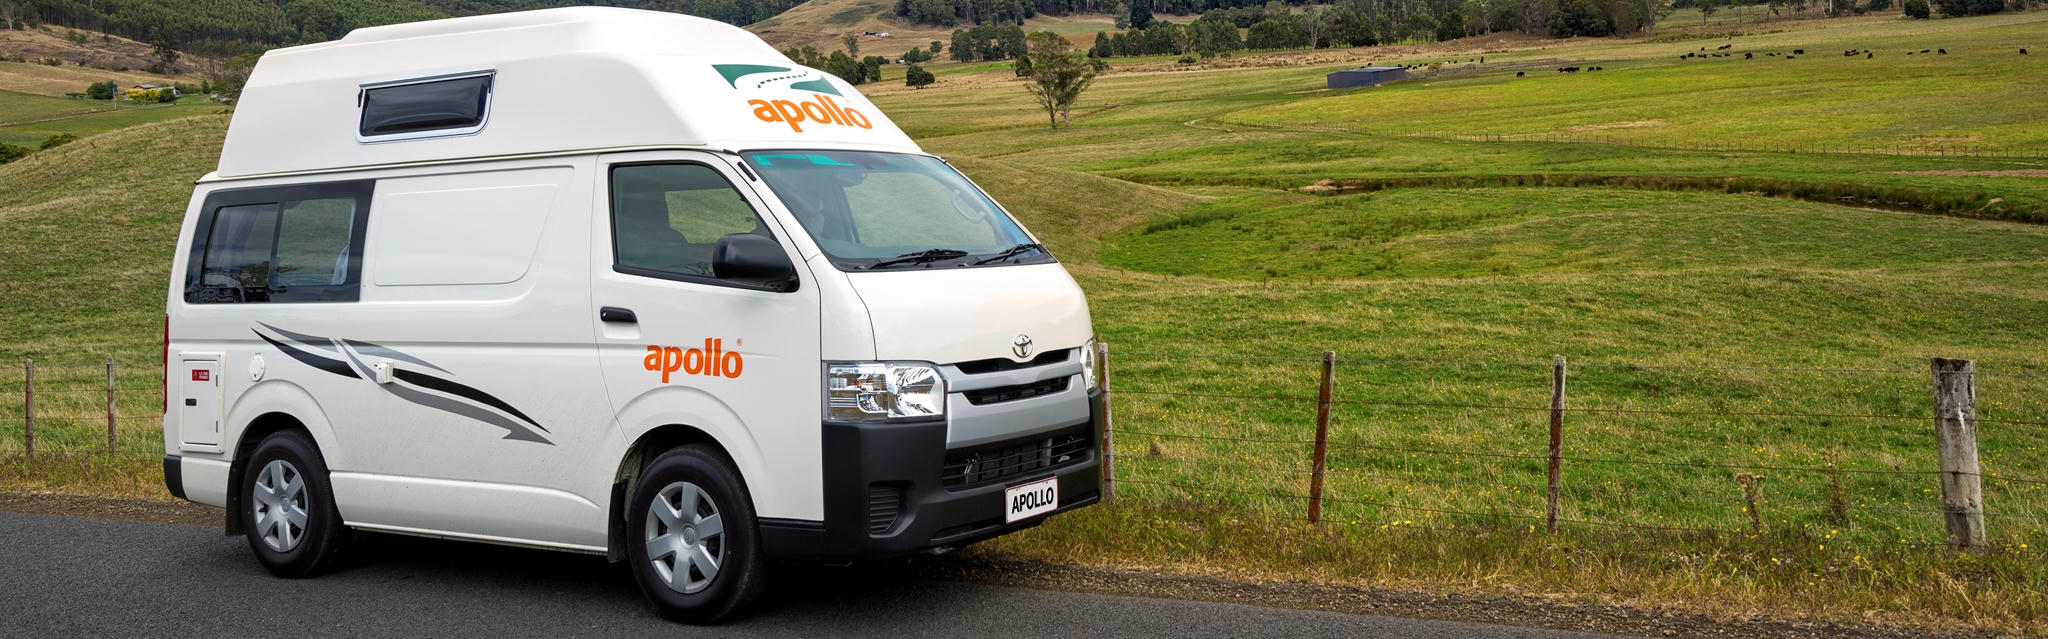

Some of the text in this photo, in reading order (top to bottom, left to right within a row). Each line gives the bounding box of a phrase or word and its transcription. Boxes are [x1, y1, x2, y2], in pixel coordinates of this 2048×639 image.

[747, 94, 873, 133] apollo
[643, 337, 743, 384] apollo
[1011, 486, 1054, 515] APOLLO
